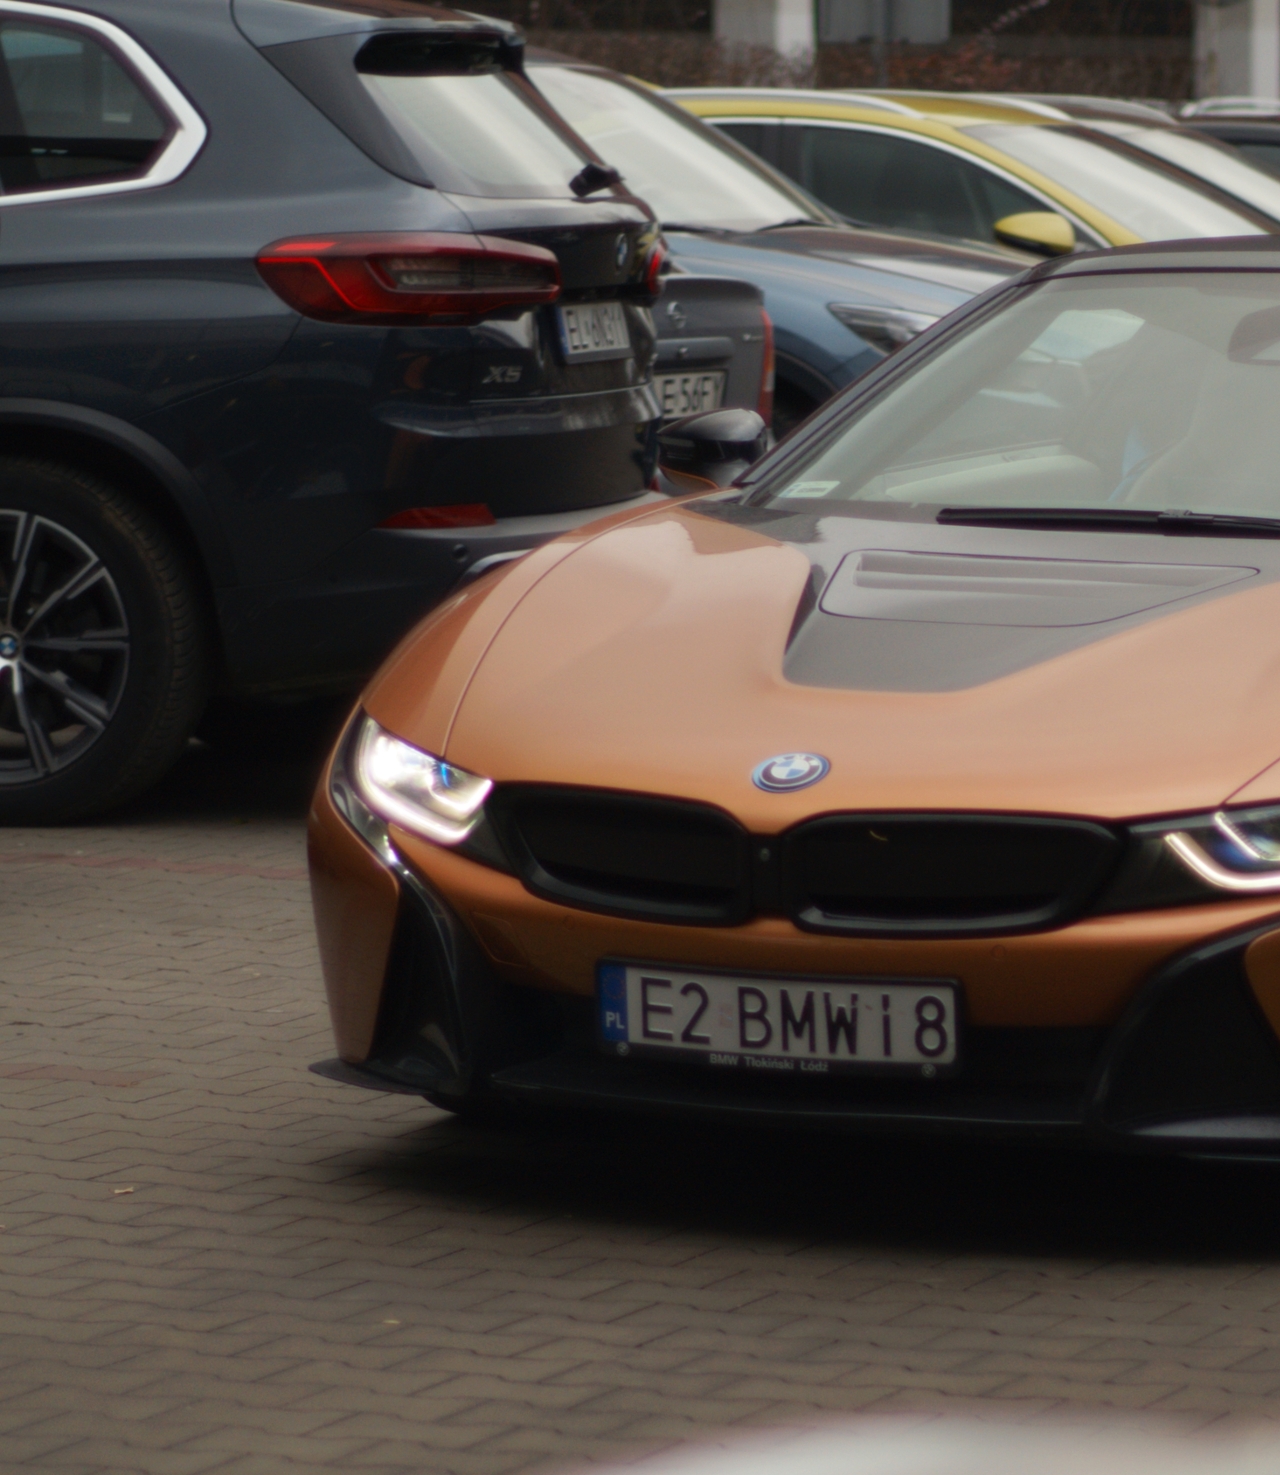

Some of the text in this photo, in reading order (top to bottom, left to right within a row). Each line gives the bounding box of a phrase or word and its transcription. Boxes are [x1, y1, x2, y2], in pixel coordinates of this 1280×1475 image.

[566, 309, 589, 351] EL
[481, 365, 523, 384] X5
[605, 1011, 626, 1030] PL
[640, 976, 711, 1046] E2
[709, 1053, 739, 1067] BMW
